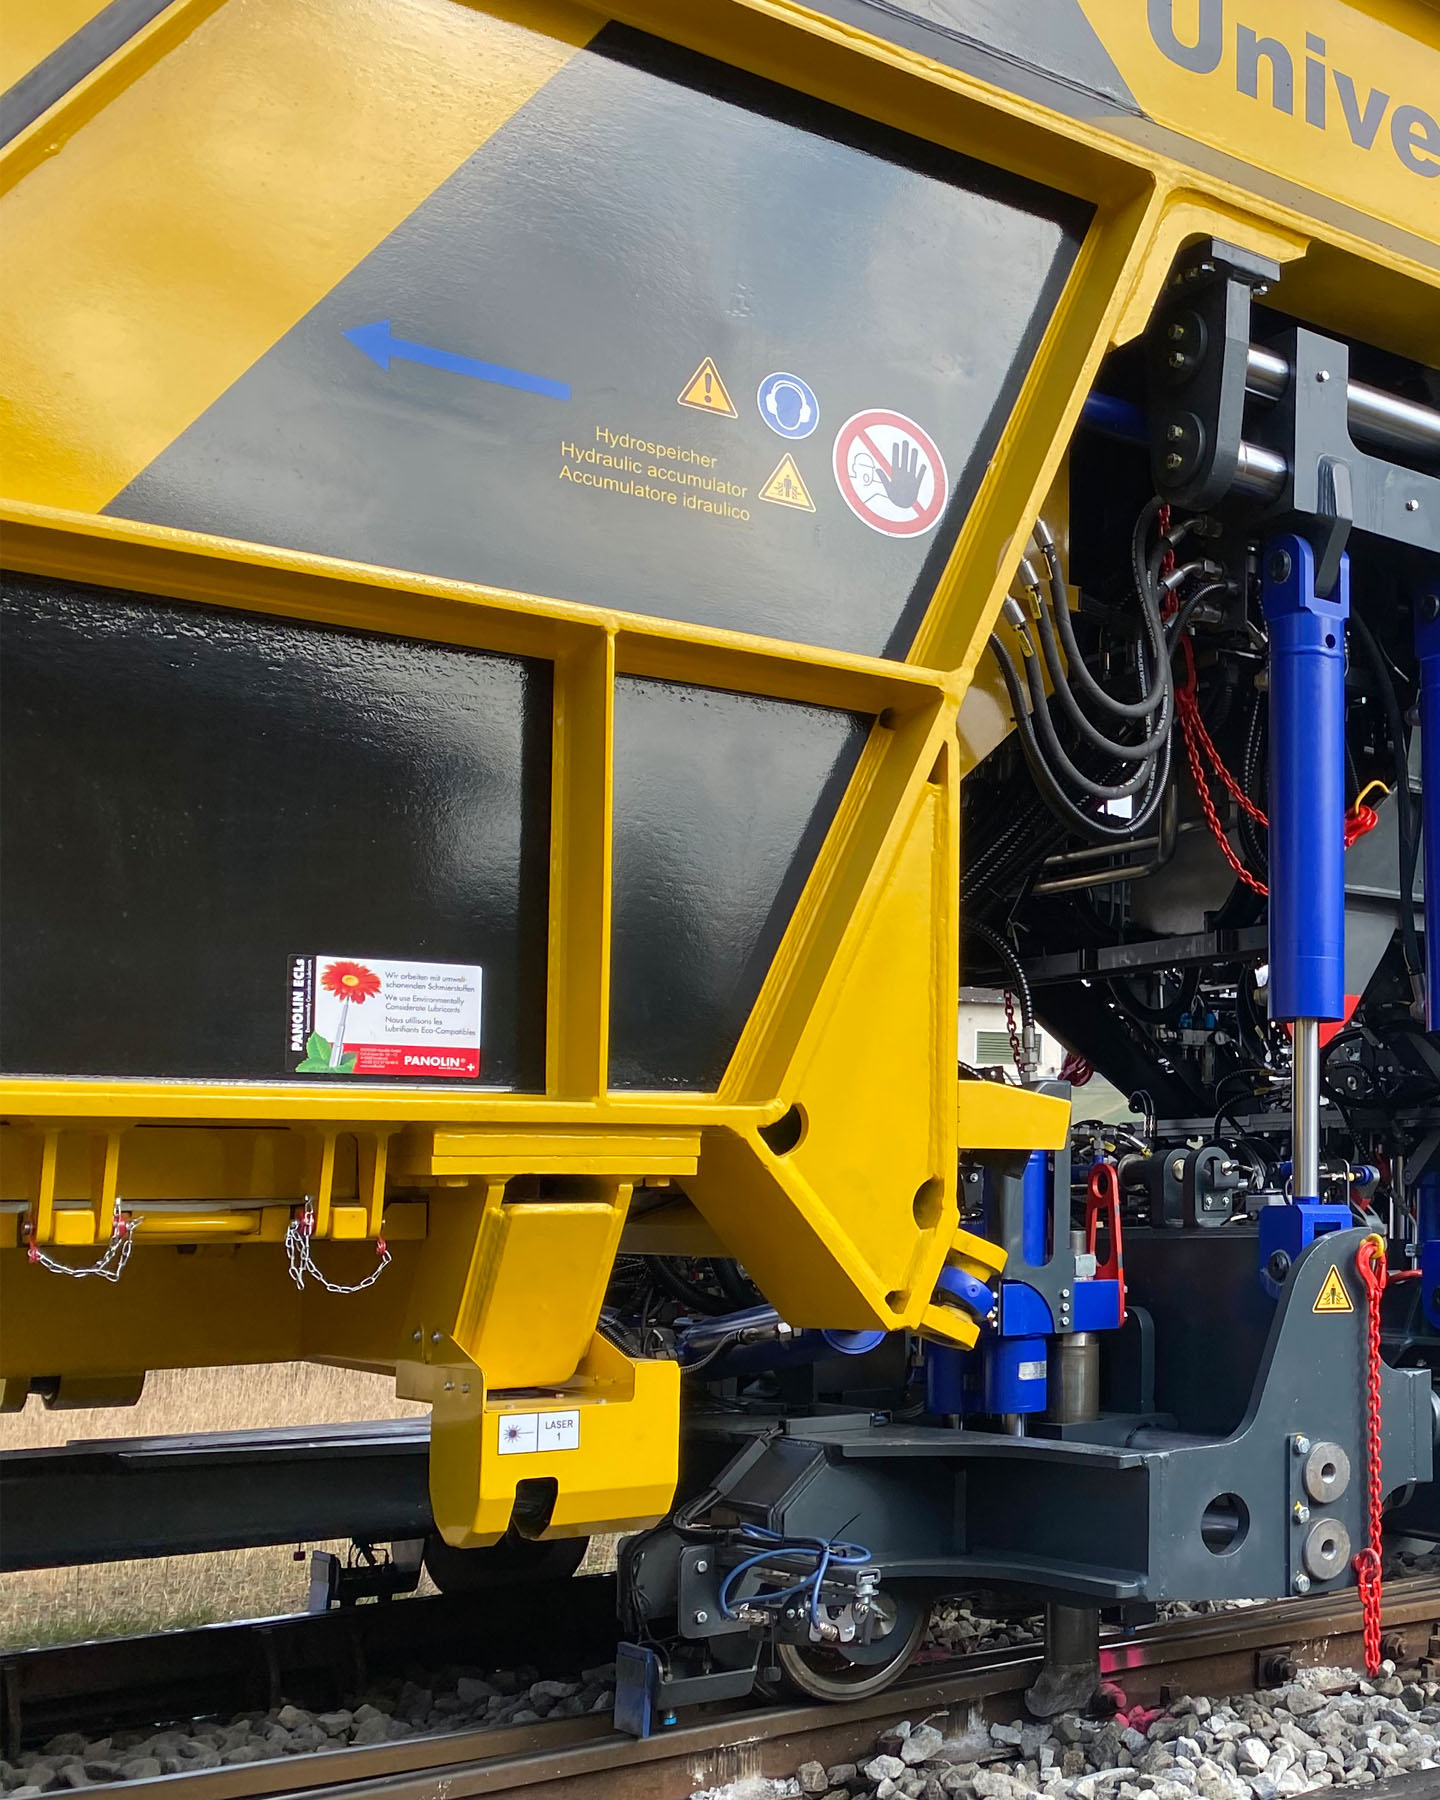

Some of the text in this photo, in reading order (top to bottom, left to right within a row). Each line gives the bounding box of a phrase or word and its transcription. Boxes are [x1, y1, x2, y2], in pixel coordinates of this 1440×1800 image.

[595, 425, 718, 469] Hydrospeicher
[560, 441, 748, 498] Hydraulic accumulator
[559, 464, 750, 521] Accumulatore idraulico
[385, 971, 399, 979] Wir
[385, 993, 397, 1001] We
[292, 991, 305, 1052] PANOLIN
[545, 1419, 574, 1430] LASER
